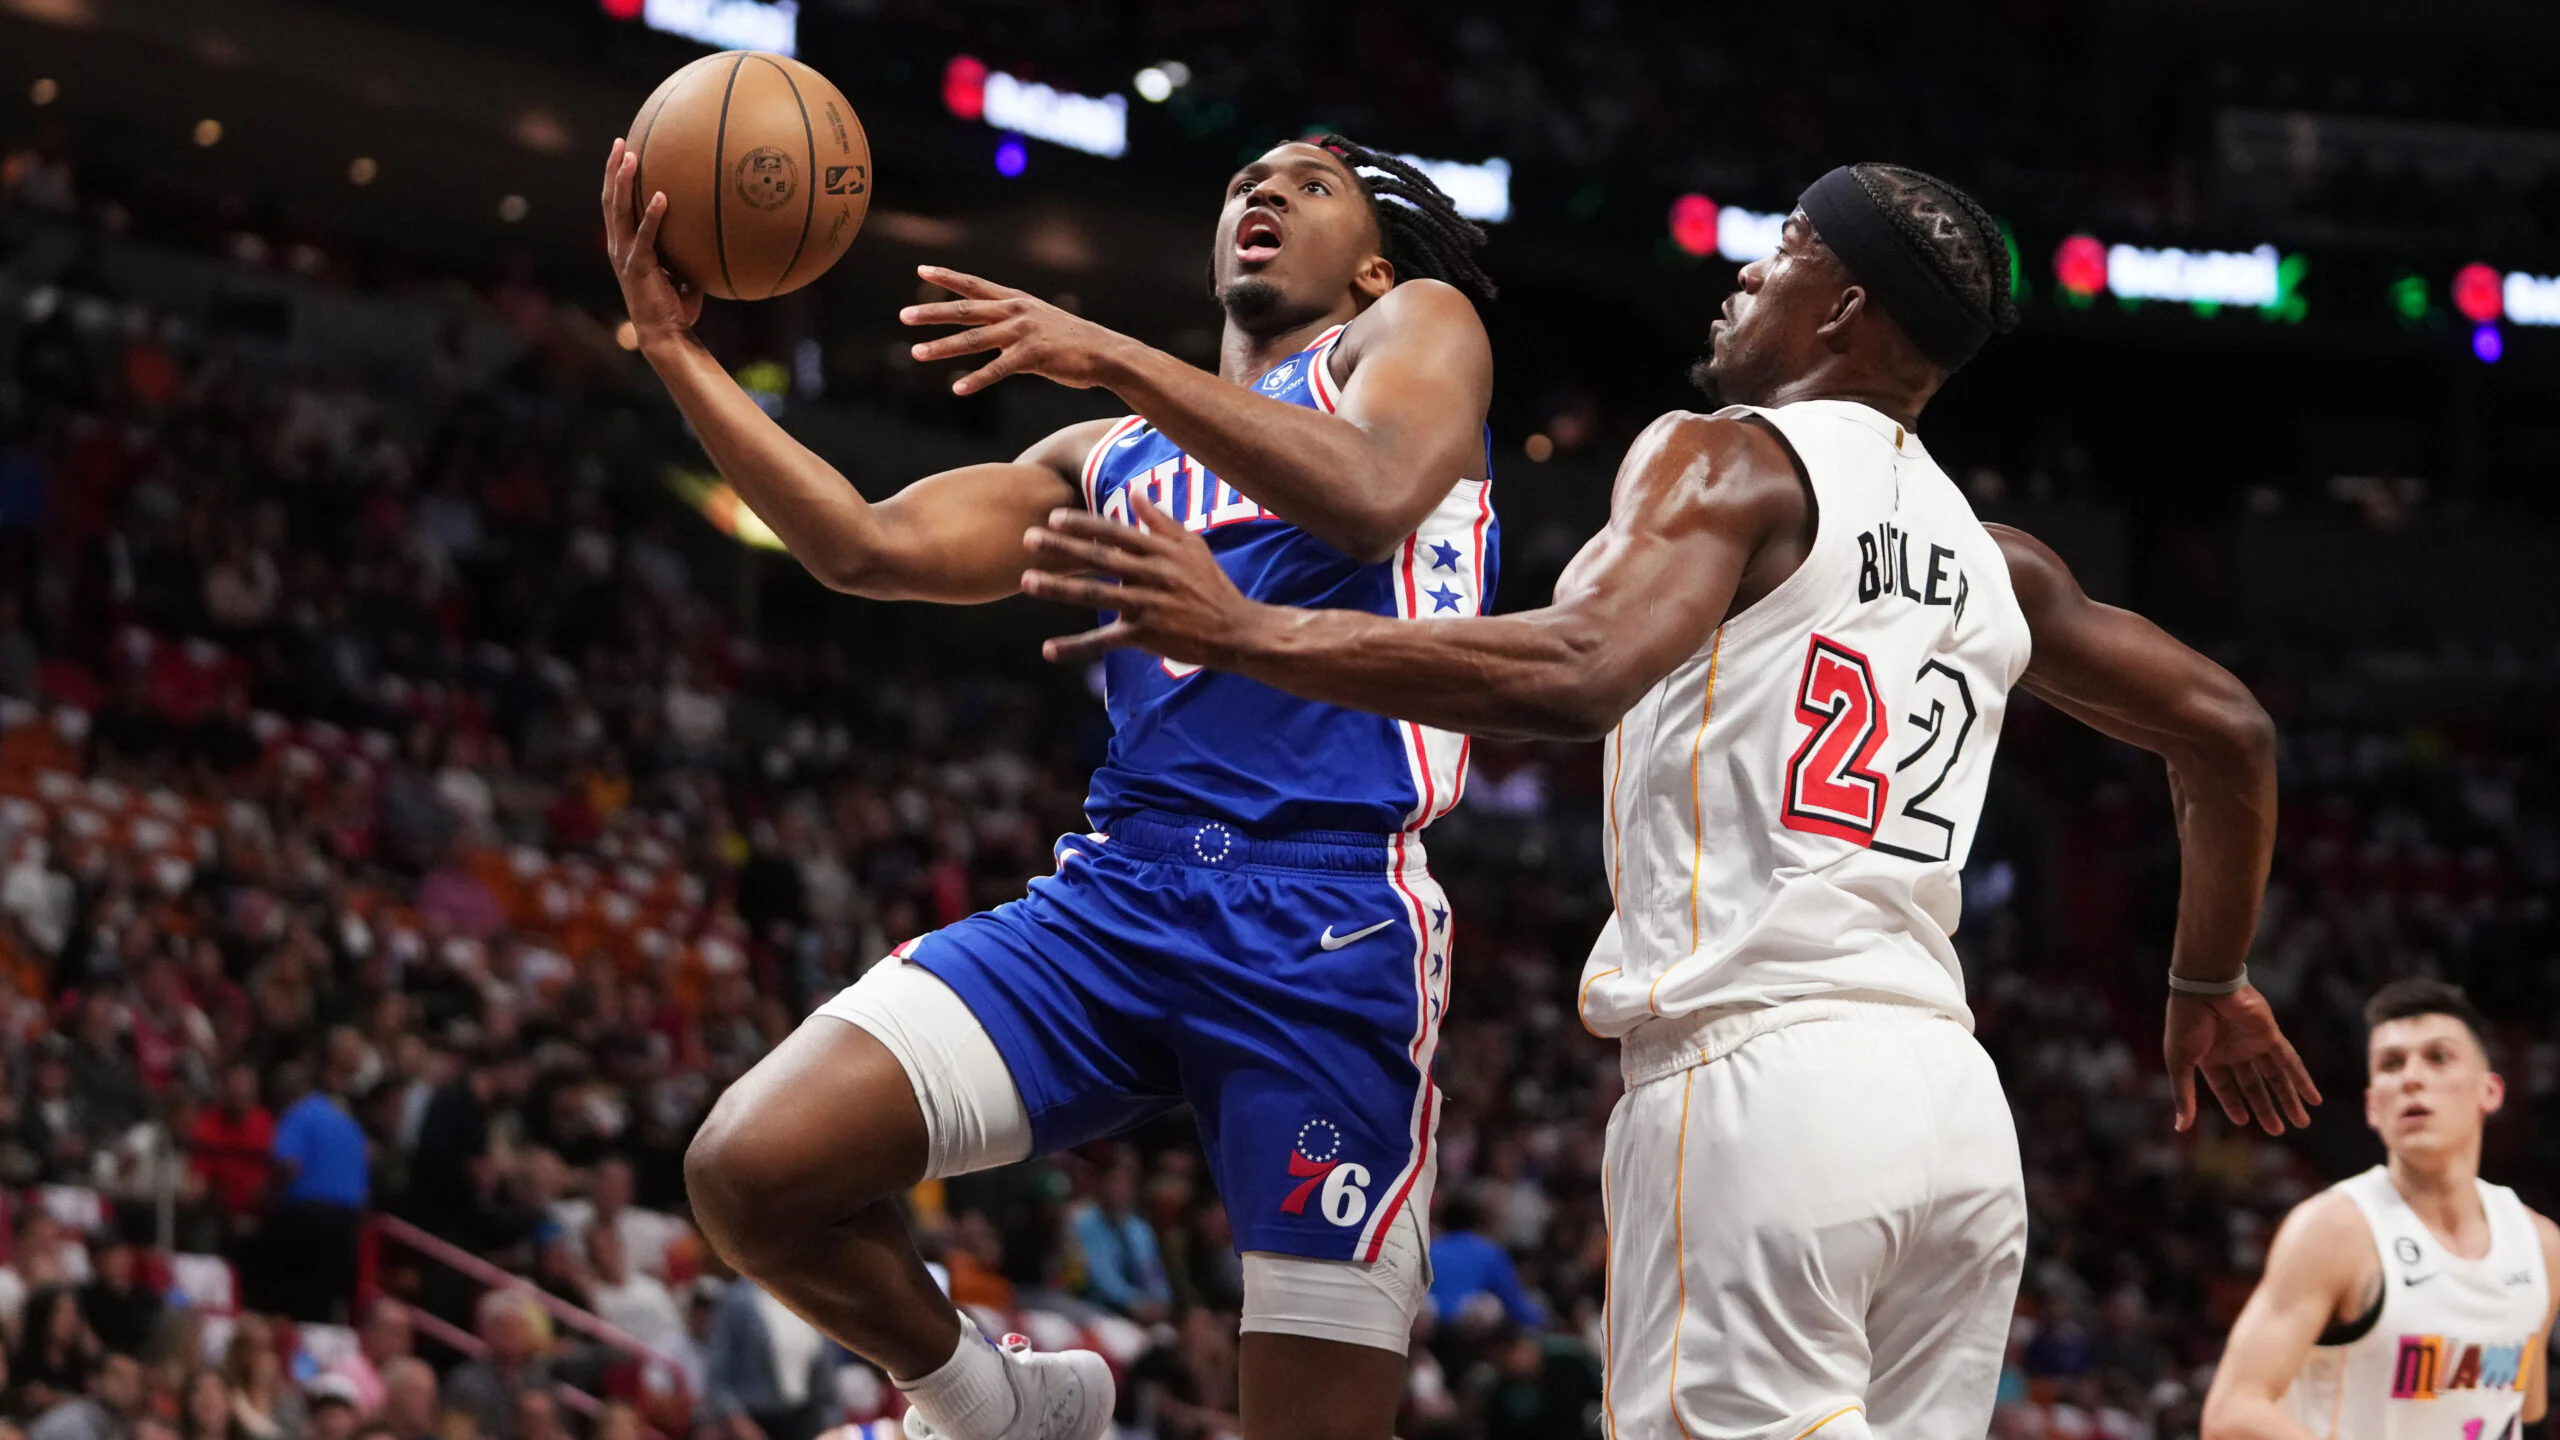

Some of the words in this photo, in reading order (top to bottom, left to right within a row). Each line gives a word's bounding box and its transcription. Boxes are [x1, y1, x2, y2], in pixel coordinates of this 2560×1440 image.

[1102, 453, 1282, 536] HIL
[1781, 632, 1977, 863] 22
[1280, 1150, 1371, 1227] 76
[2391, 1333, 2538, 1400] MIAMI
